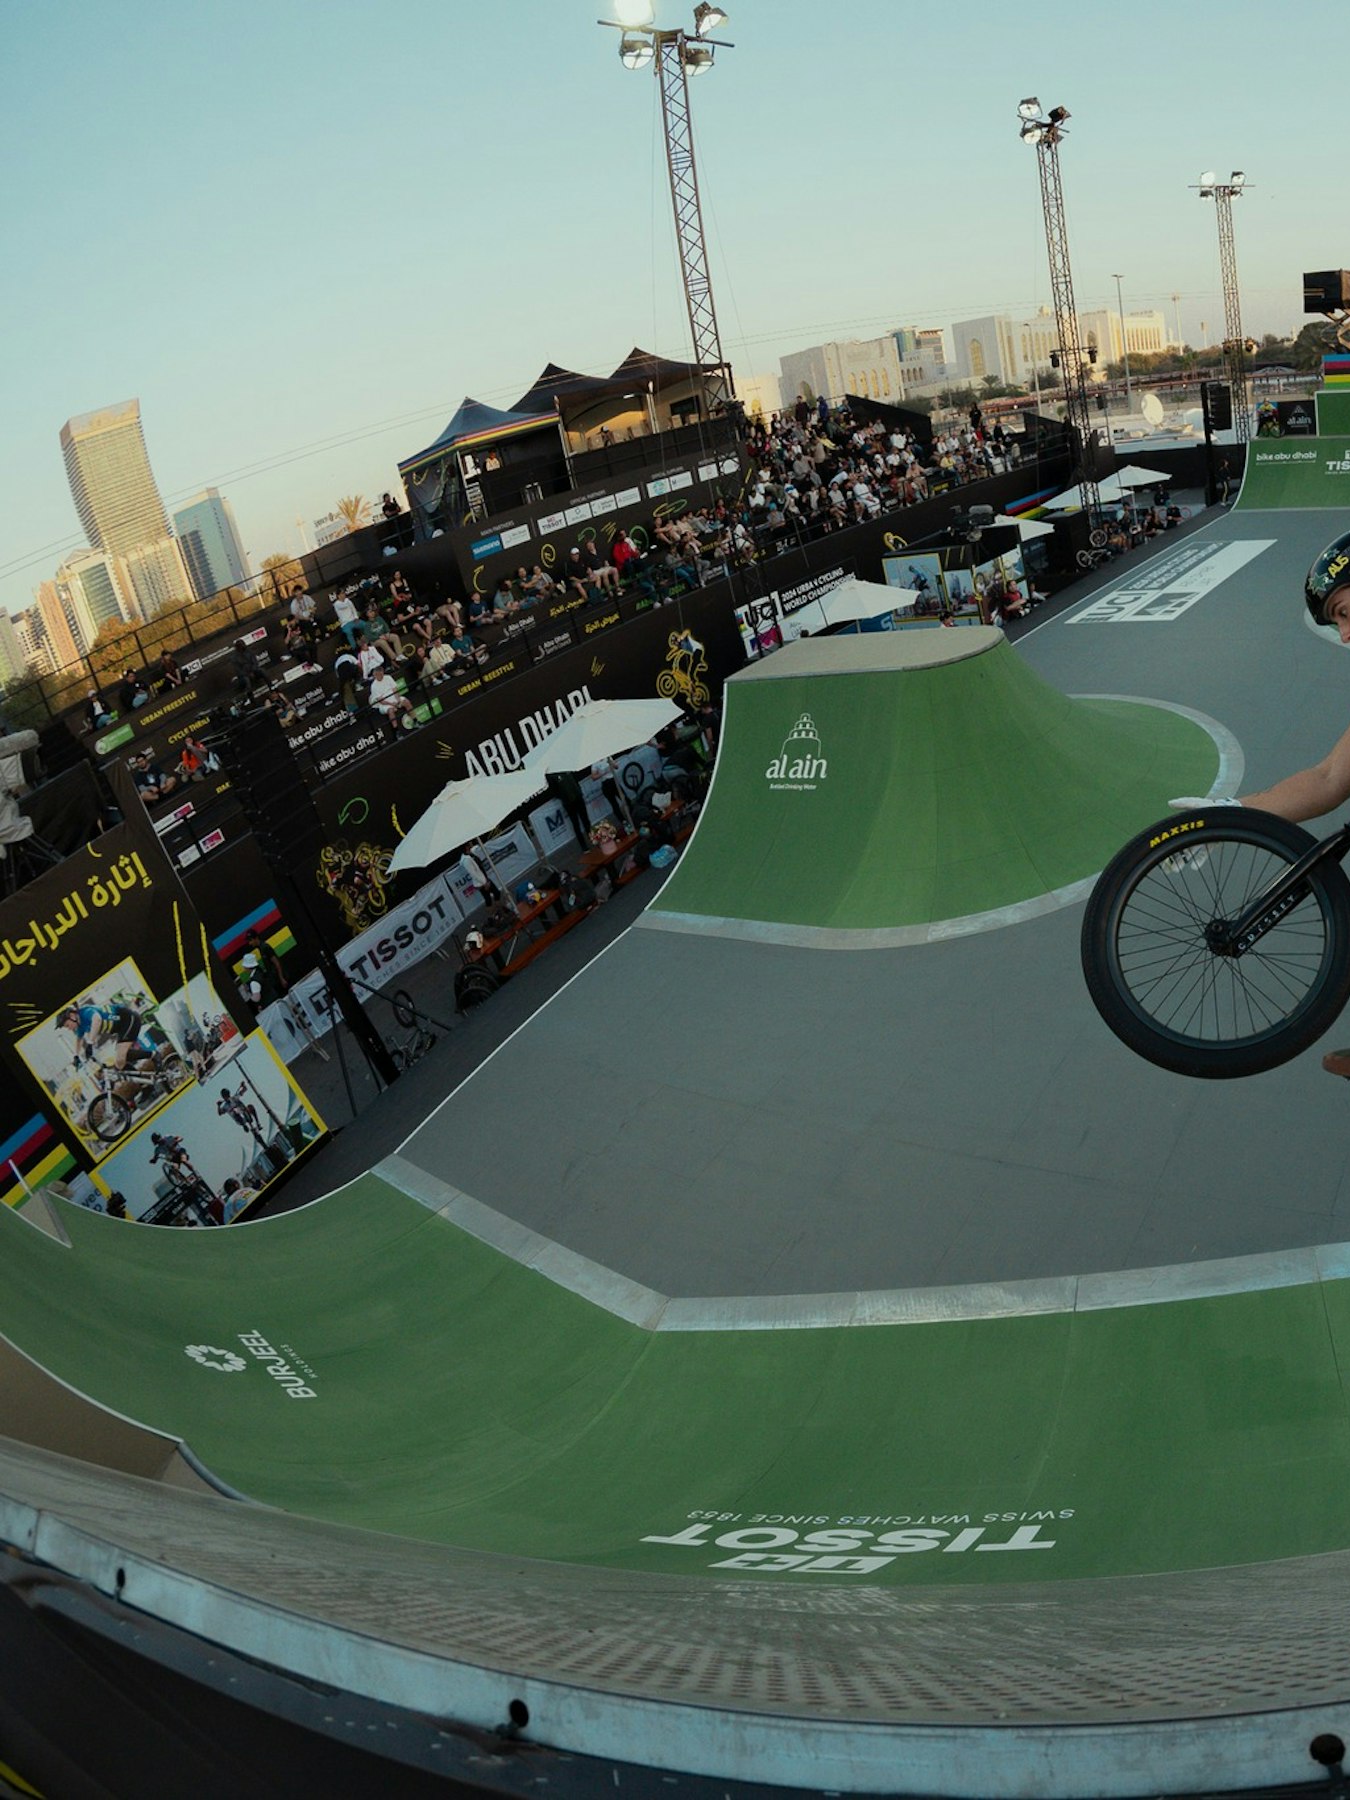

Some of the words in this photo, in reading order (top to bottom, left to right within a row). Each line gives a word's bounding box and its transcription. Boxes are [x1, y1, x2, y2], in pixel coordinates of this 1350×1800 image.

[1256, 452, 1273, 461] bike
[1274, 452, 1291, 460] abu
[1292, 450, 1318, 460] dhabi
[783, 598, 806, 612] WORLD
[303, 722, 324, 740] abu
[323, 709, 350, 728] dhab
[336, 744, 356, 763] abu
[463, 727, 522, 778] ABU
[765, 753, 788, 779] al
[788, 753, 828, 779] ain
[1149, 818, 1206, 849] MAXXIS
[87, 851, 152, 907] إثارة
[349, 895, 446, 981] TISSOT
[237, 1329, 318, 1398] BURJEEL
[686, 1510, 743, 1522] 1853
[748, 1513, 830, 1525] SINCE
[836, 1513, 971, 1526] WATCHES
[982, 1508, 1076, 1522] SWISS
[638, 1524, 1057, 1553] TISSOT
